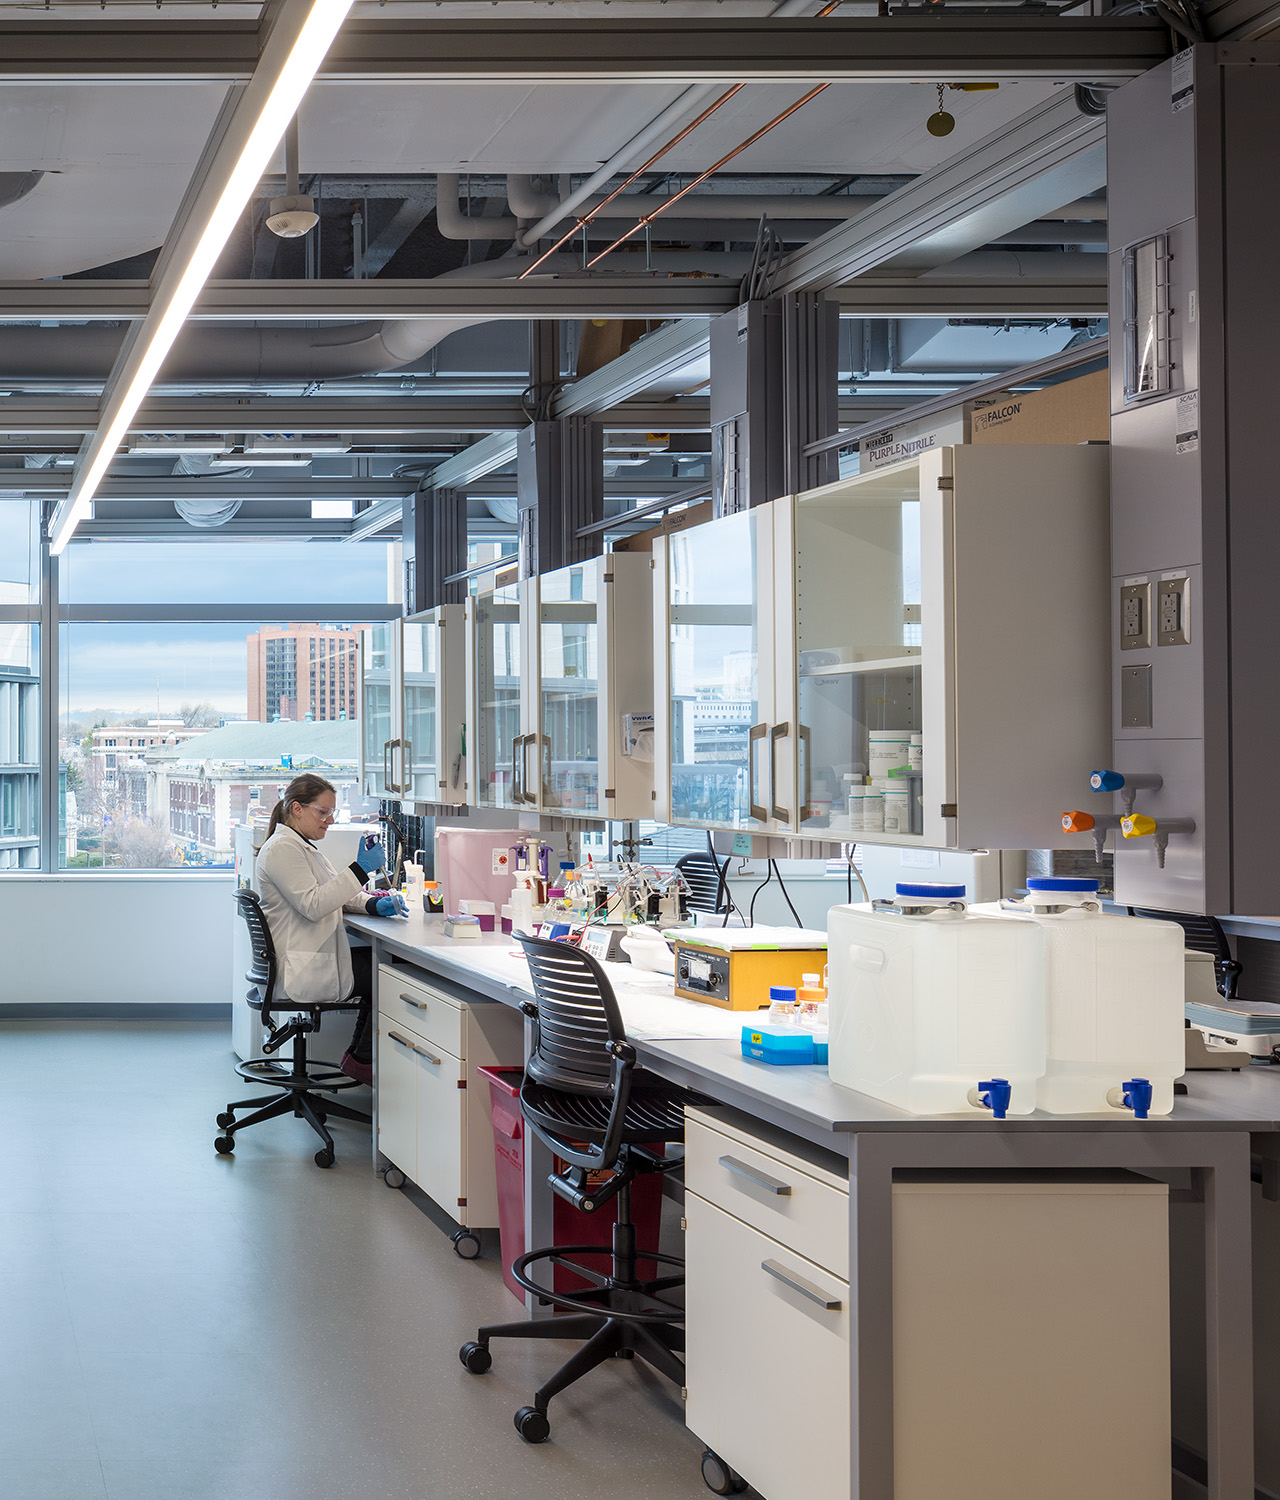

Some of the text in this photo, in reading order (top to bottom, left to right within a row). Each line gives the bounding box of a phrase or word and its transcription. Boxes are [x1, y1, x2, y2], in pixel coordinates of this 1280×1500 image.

[1179, 393, 1197, 403] SCALA
[987, 402, 1021, 422] FALCON
[869, 443, 901, 462] PURPLE
[901, 434, 936, 455] NITRILE
